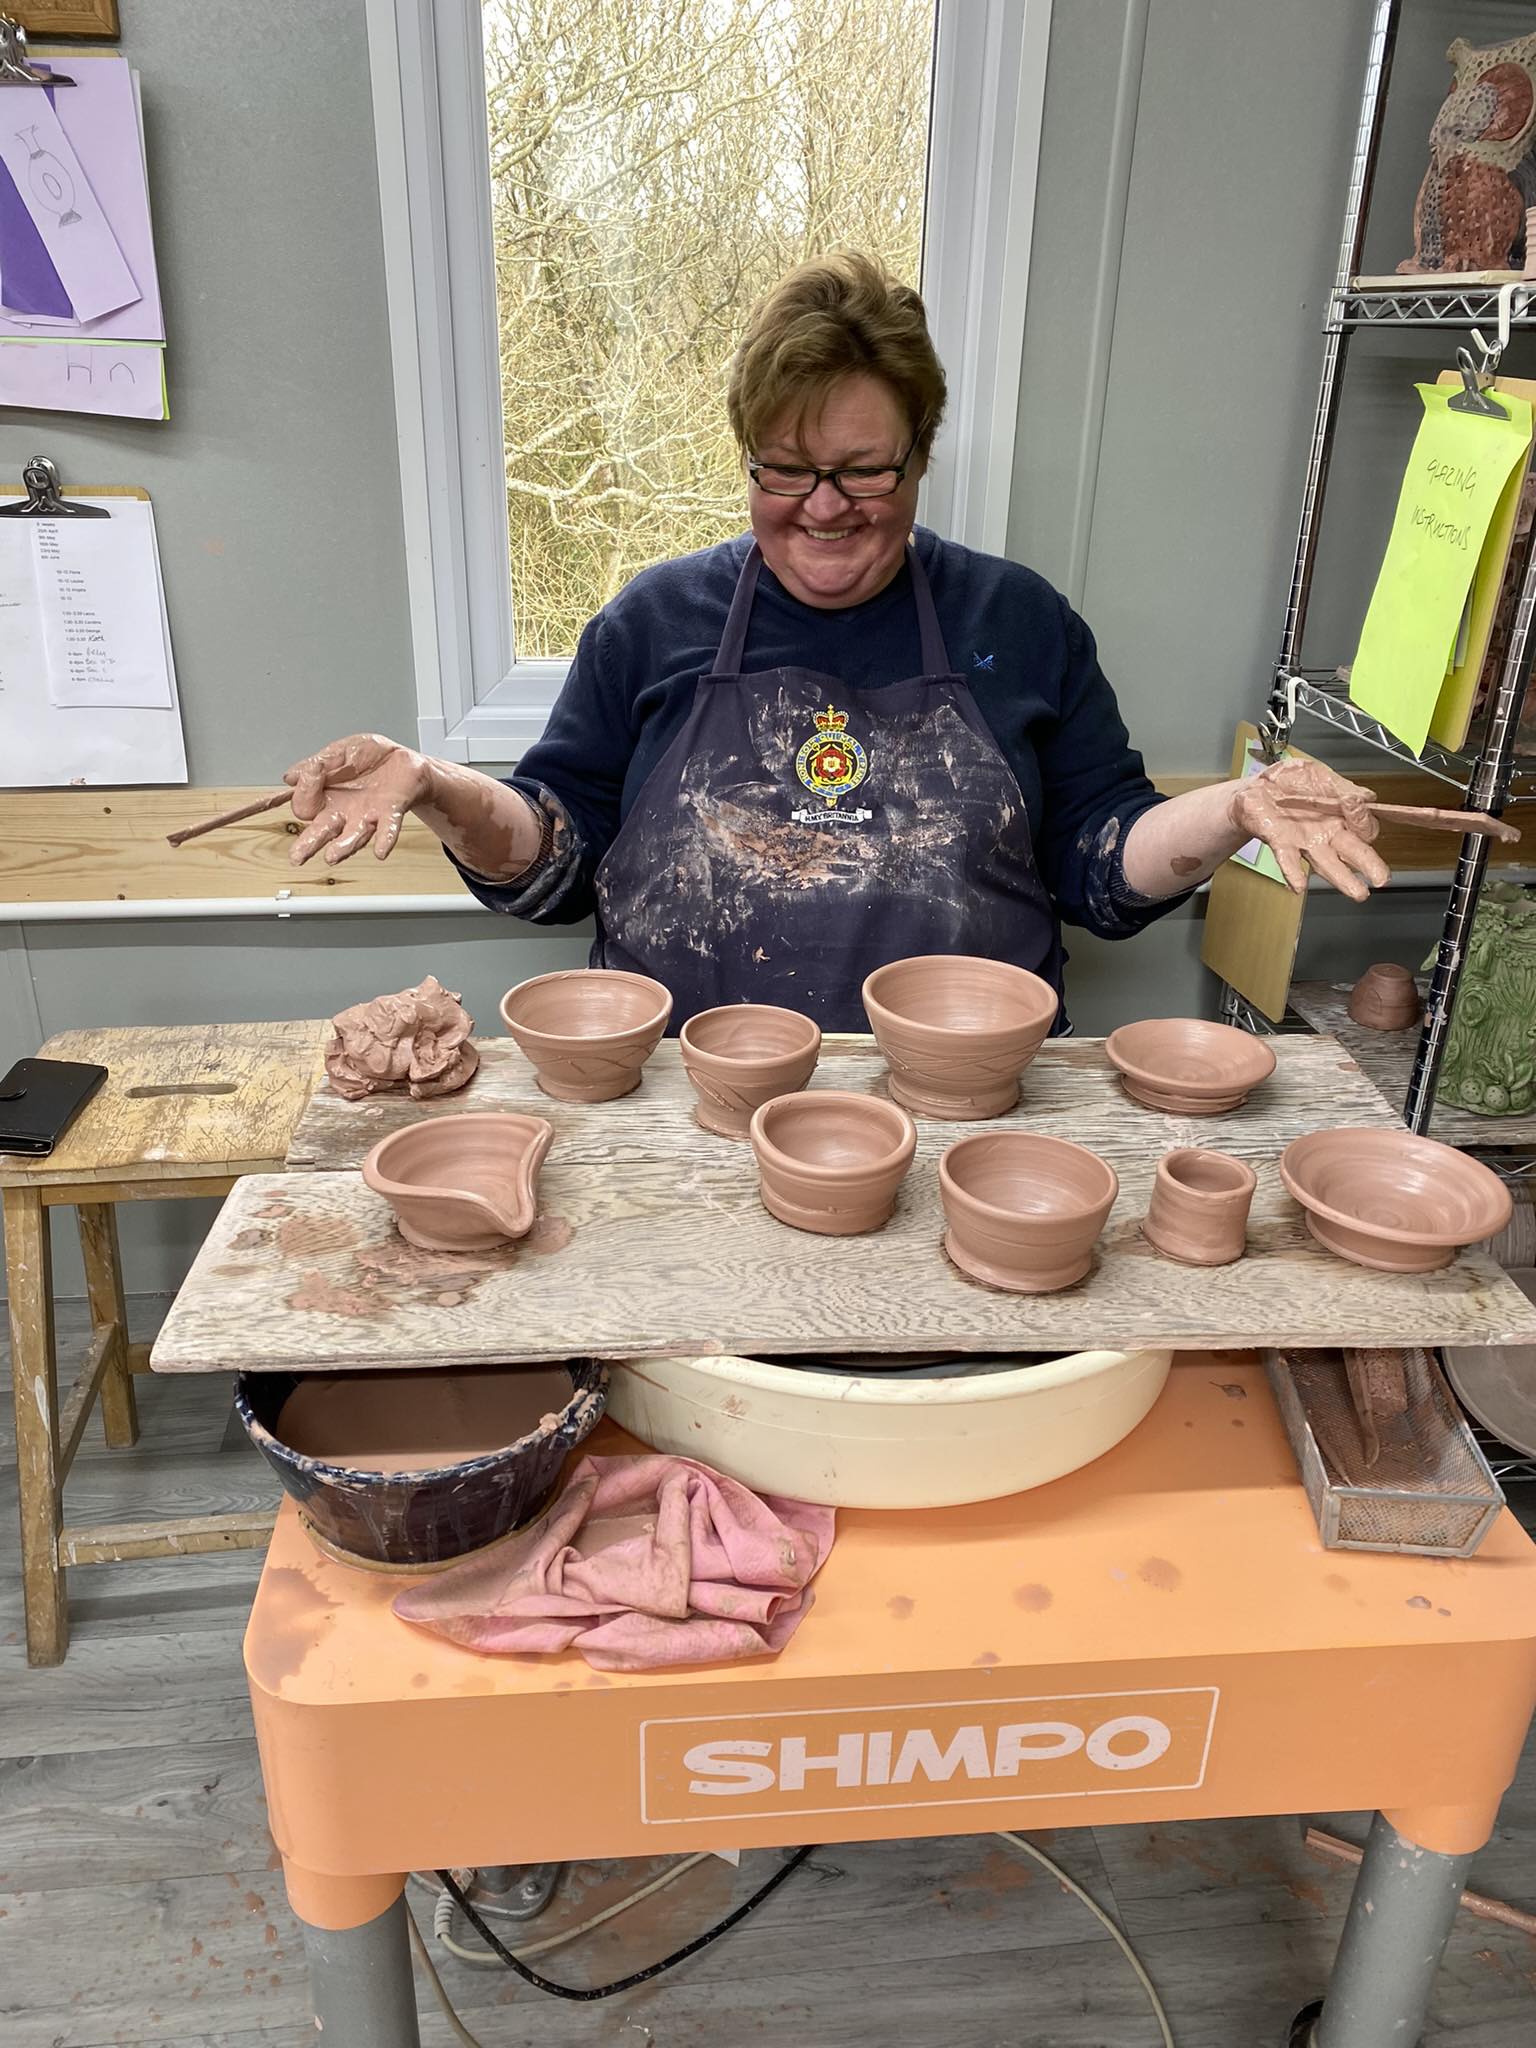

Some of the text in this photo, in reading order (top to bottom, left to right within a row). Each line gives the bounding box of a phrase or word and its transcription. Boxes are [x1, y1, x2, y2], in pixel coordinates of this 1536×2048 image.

[1411, 505, 1471, 550] INSTRUCTIONS
[823, 812, 859, 822] BRITANNIA
[683, 1716, 1171, 1796] SHIMPO
